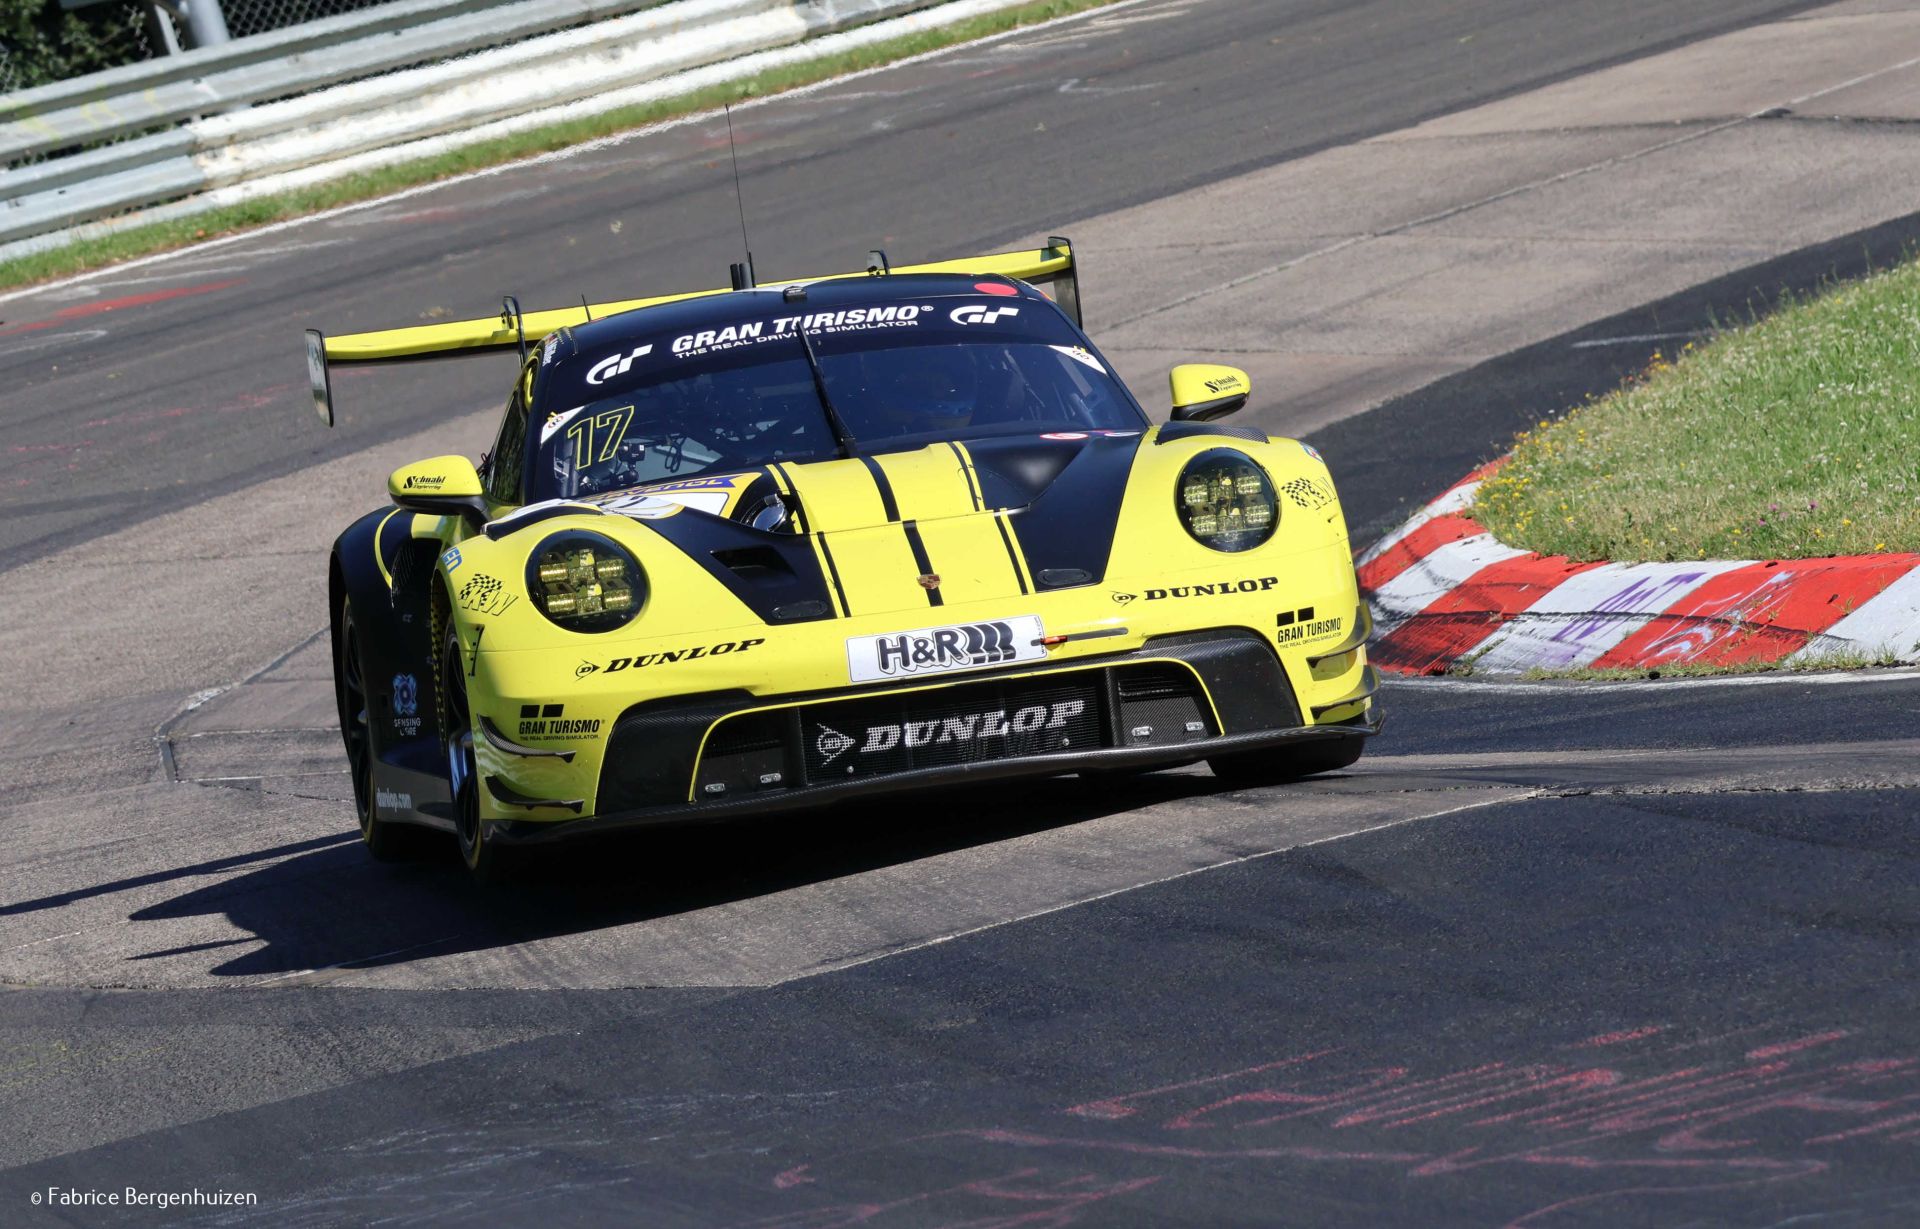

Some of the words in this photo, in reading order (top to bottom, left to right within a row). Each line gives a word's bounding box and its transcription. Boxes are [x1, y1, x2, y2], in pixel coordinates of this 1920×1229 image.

[671, 321, 763, 353] GRAN
[675, 347, 707, 359] THE
[711, 340, 753, 352] REAL
[826, 320, 918, 333] SIMULATOR
[567, 405, 635, 471] 17
[1144, 576, 1279, 601] DUNLOP
[877, 628, 966, 671] H&R
[1278, 625, 1303, 643] GRAN
[602, 638, 766, 674] DUNLOP
[519, 721, 546, 735] GRAN
[859, 699, 1085, 752] DUNLOP
